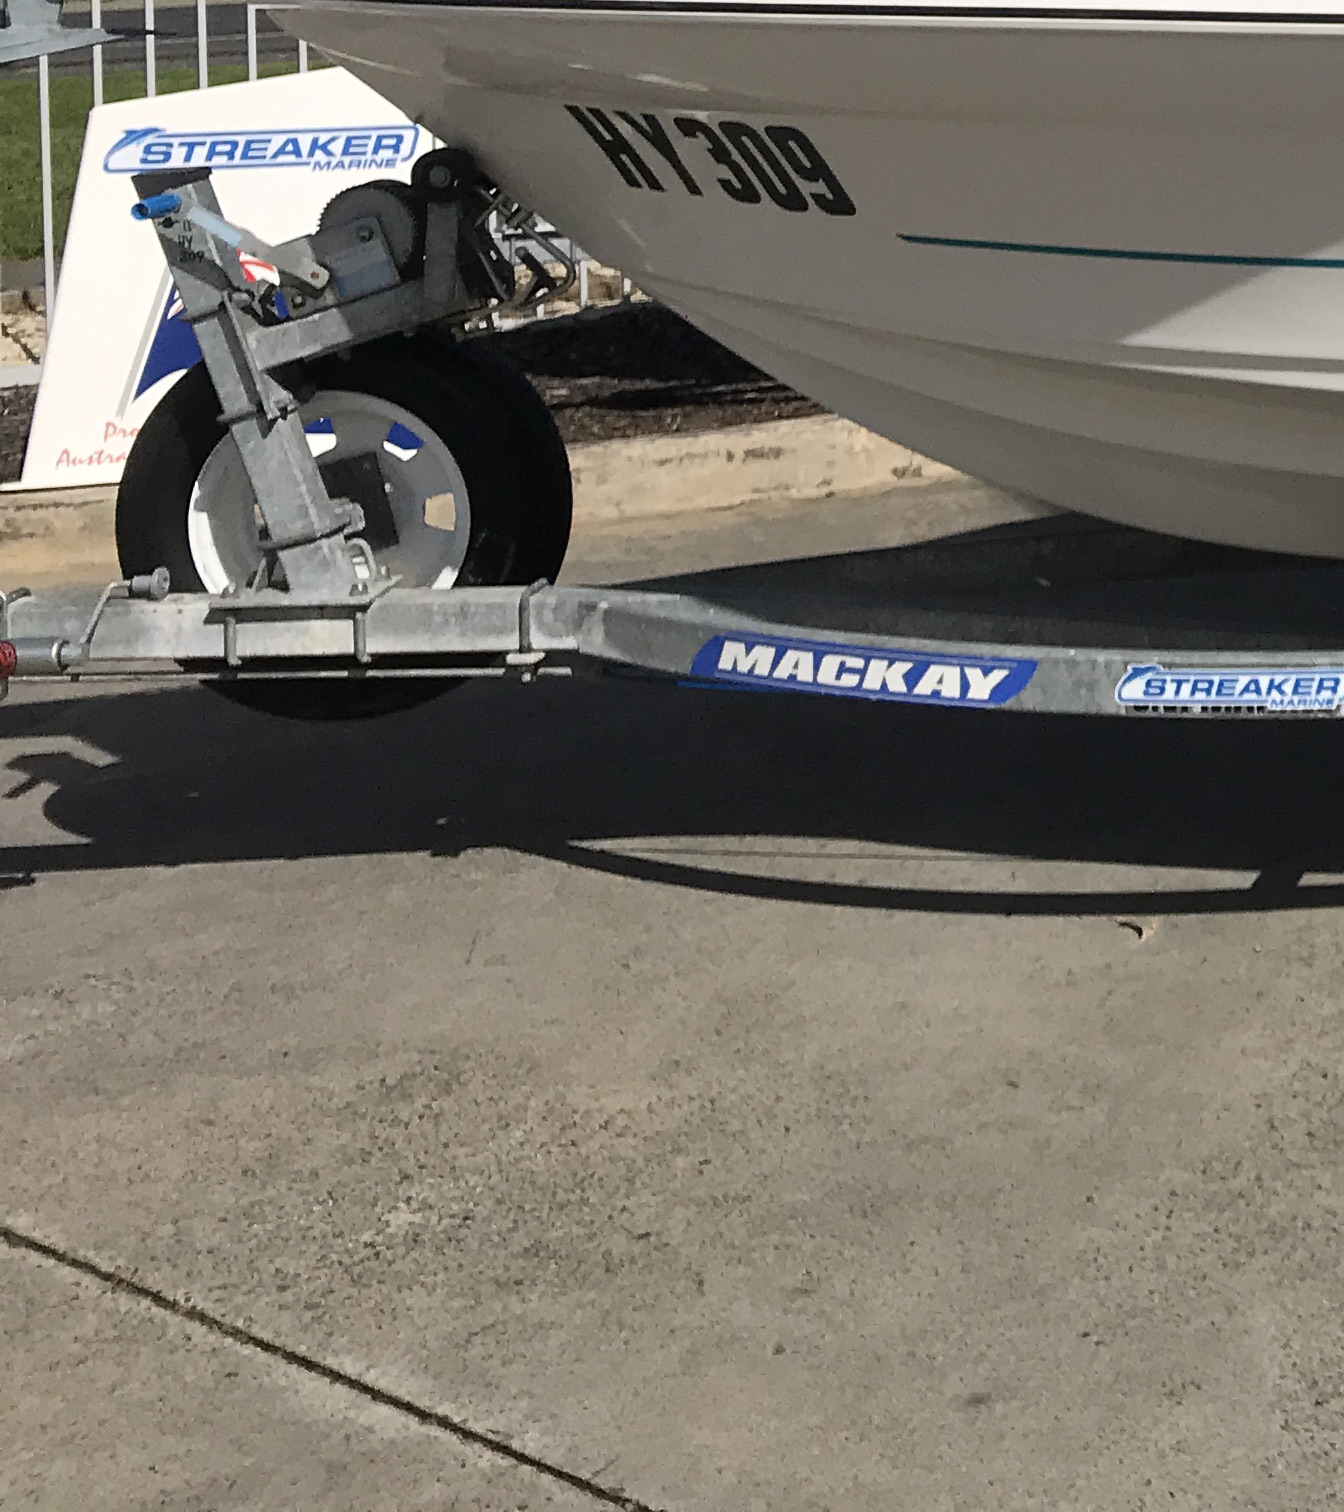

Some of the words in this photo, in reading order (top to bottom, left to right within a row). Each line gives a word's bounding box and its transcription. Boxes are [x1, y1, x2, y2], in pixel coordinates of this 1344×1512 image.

[139, 134, 405, 164] STREAKER
[311, 158, 398, 172] MARINE
[103, 421, 142, 442] Pro
[55, 448, 129, 470] Austra
[717, 640, 1010, 702] MACKAY
[1142, 676, 1341, 697] STREAKER
[1269, 697, 1334, 709] MARINE
